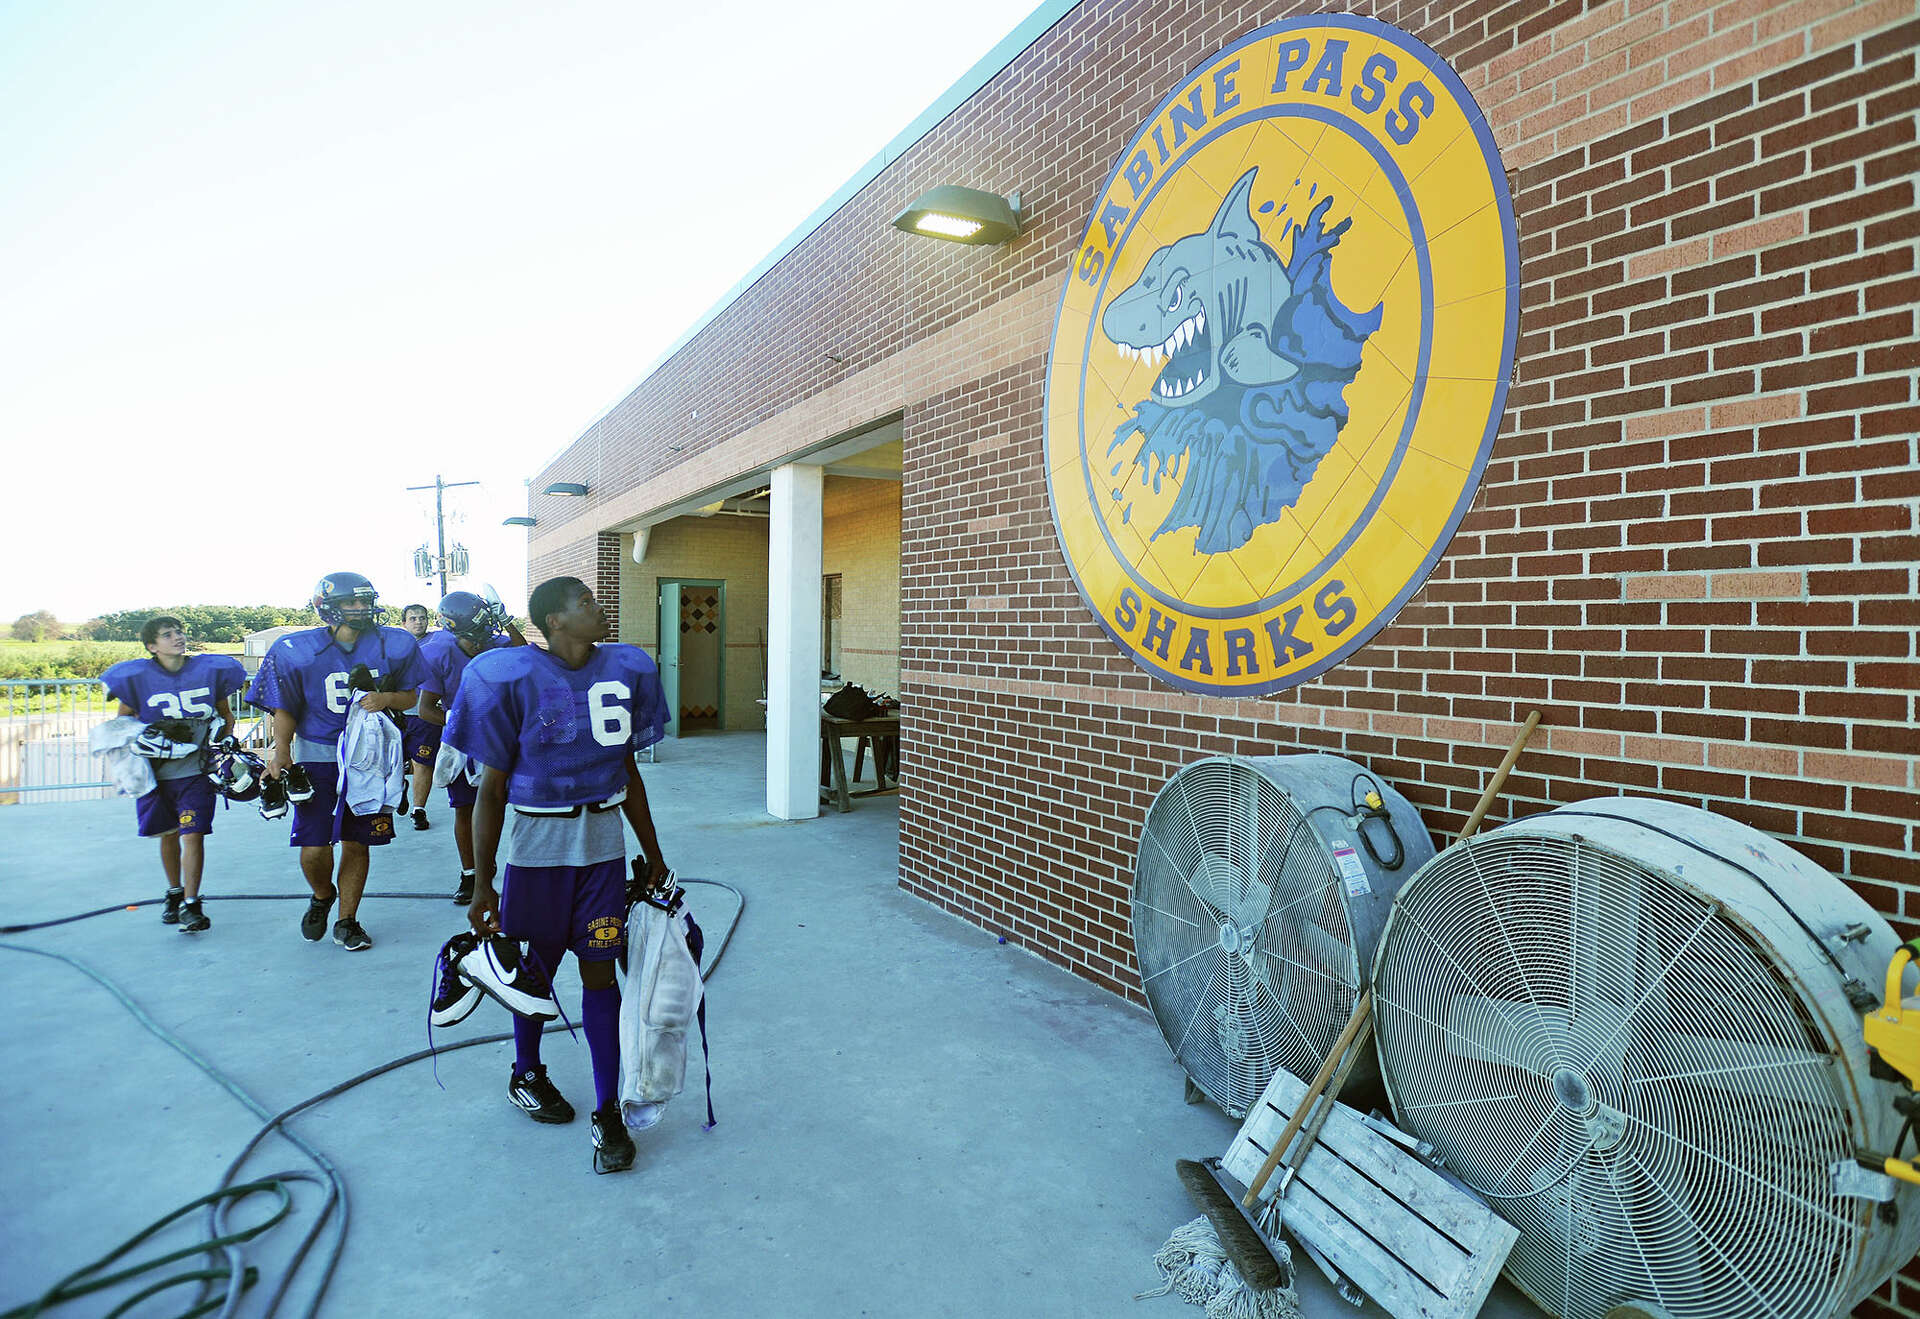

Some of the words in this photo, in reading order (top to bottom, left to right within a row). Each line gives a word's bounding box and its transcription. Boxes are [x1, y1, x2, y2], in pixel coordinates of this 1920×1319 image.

[1079, 59, 1241, 287] SABINE
[1271, 38, 1435, 146] PASS
[1115, 579, 1357, 677] SHARKS
[146, 687, 213, 720] 35
[587, 680, 632, 747] 6
